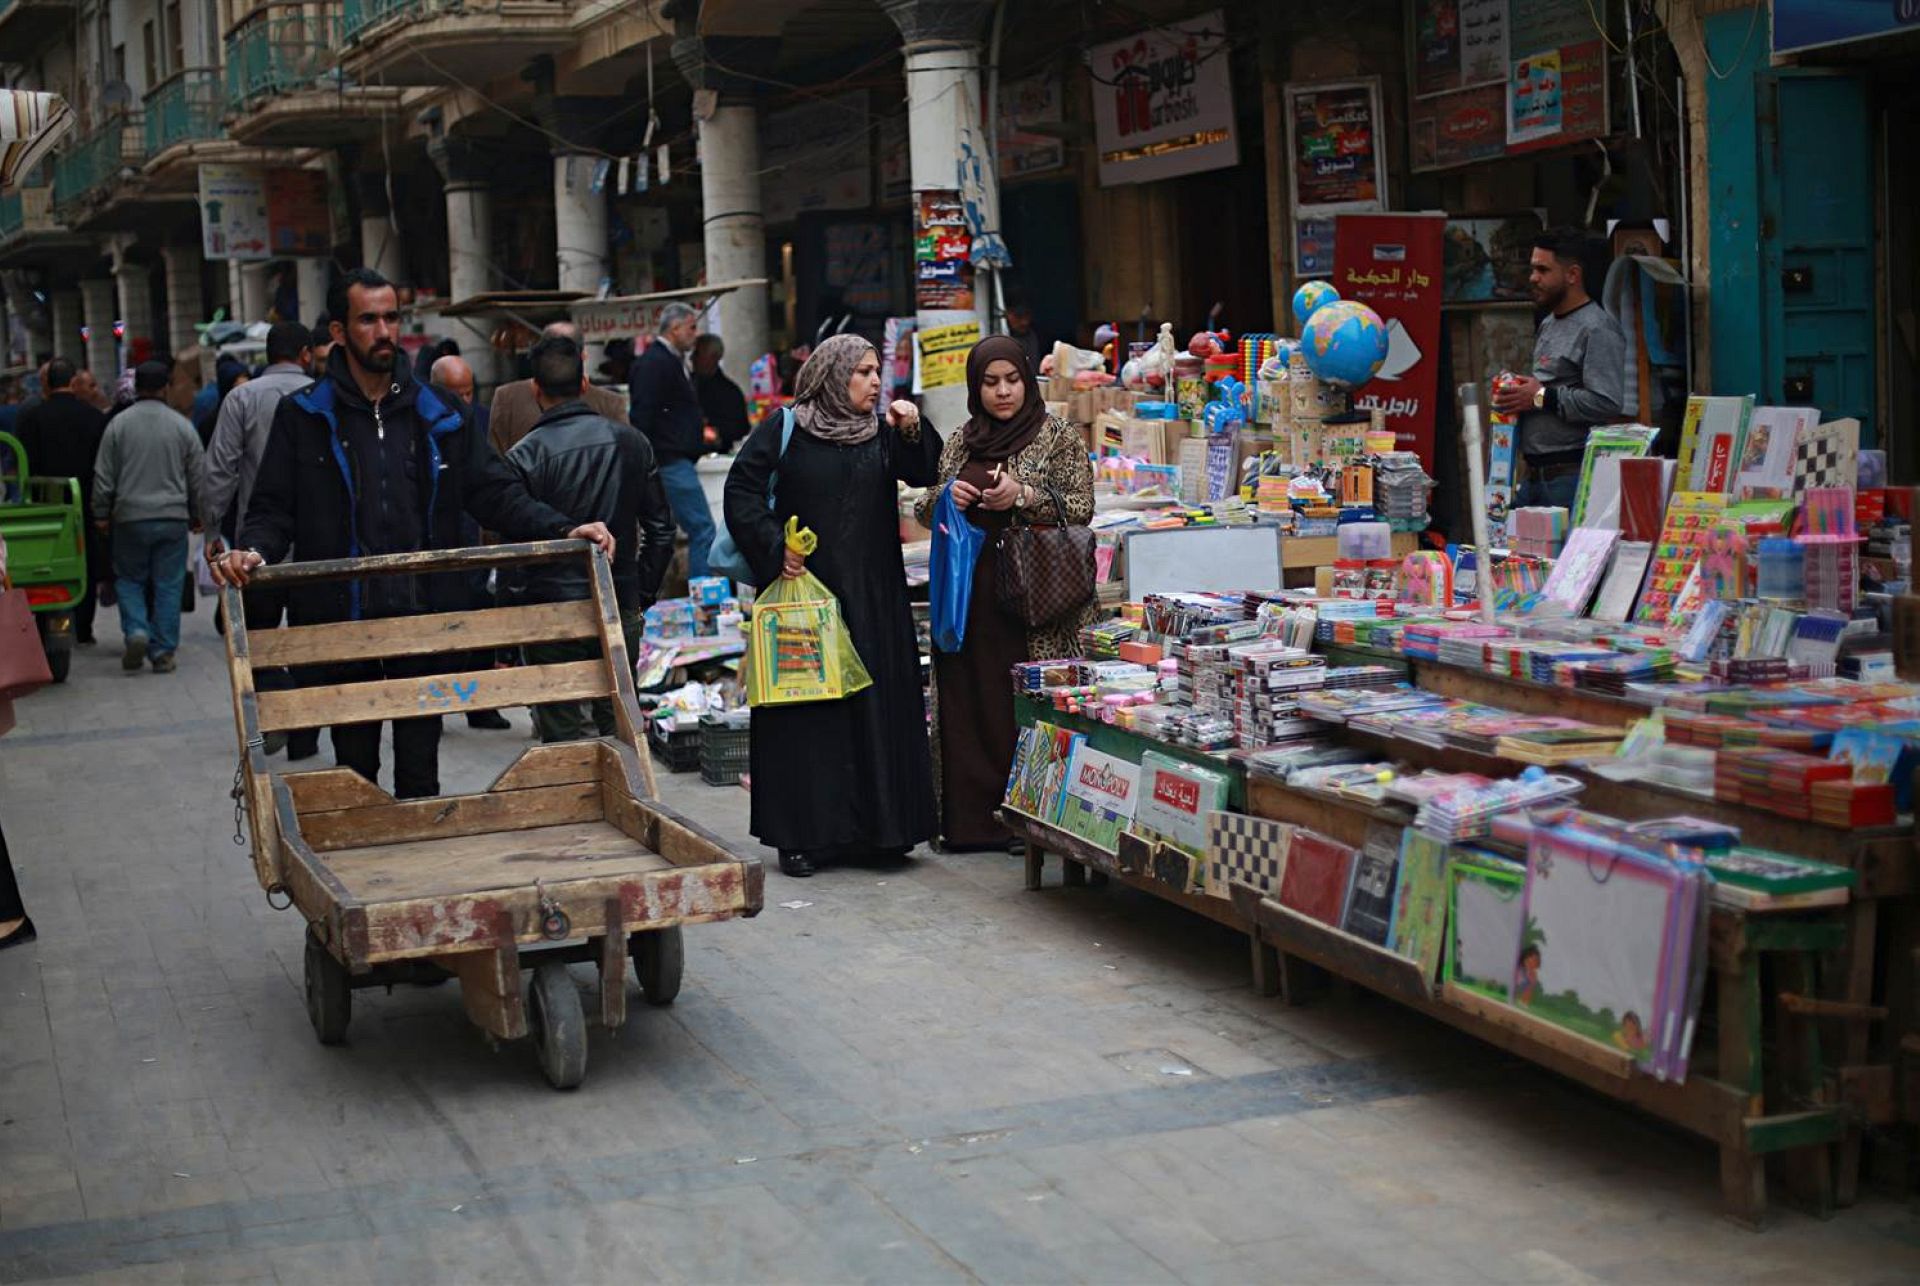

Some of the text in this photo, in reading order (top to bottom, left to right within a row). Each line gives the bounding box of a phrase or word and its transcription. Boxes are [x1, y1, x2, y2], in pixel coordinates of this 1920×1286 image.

[1346, 266, 1430, 288] دار الحكمة
[1708, 443, 1727, 487] بغداد
[1081, 766, 1129, 798] MONOPOLY
